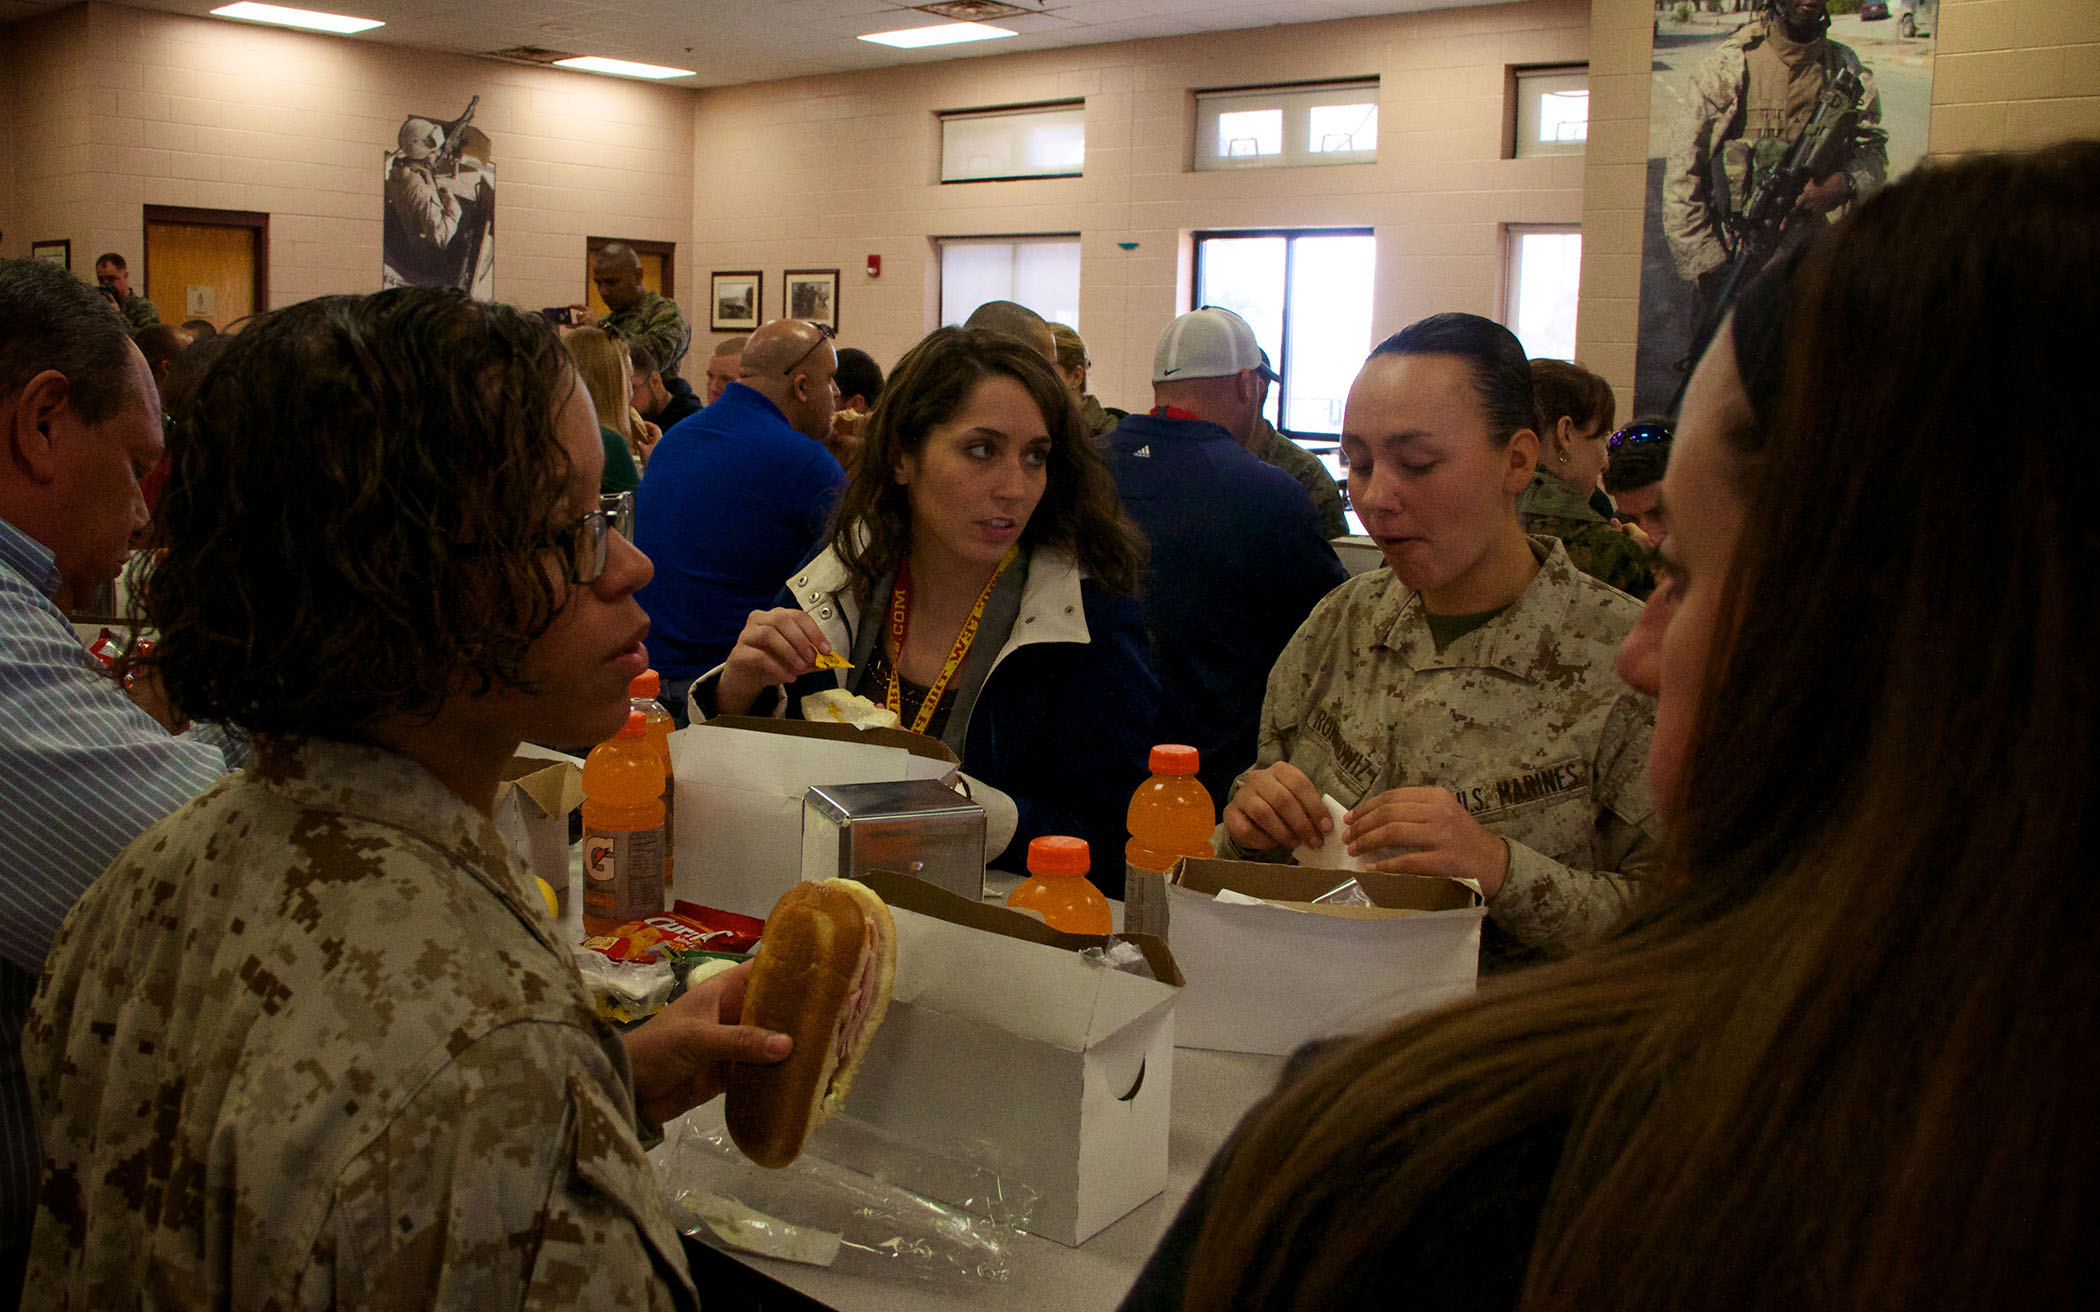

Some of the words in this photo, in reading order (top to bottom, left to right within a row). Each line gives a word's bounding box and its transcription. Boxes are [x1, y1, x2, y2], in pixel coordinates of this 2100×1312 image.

[1456, 788, 1489, 812] U.S.
[1496, 764, 1577, 806] MARINES
[585, 836, 616, 882] G
